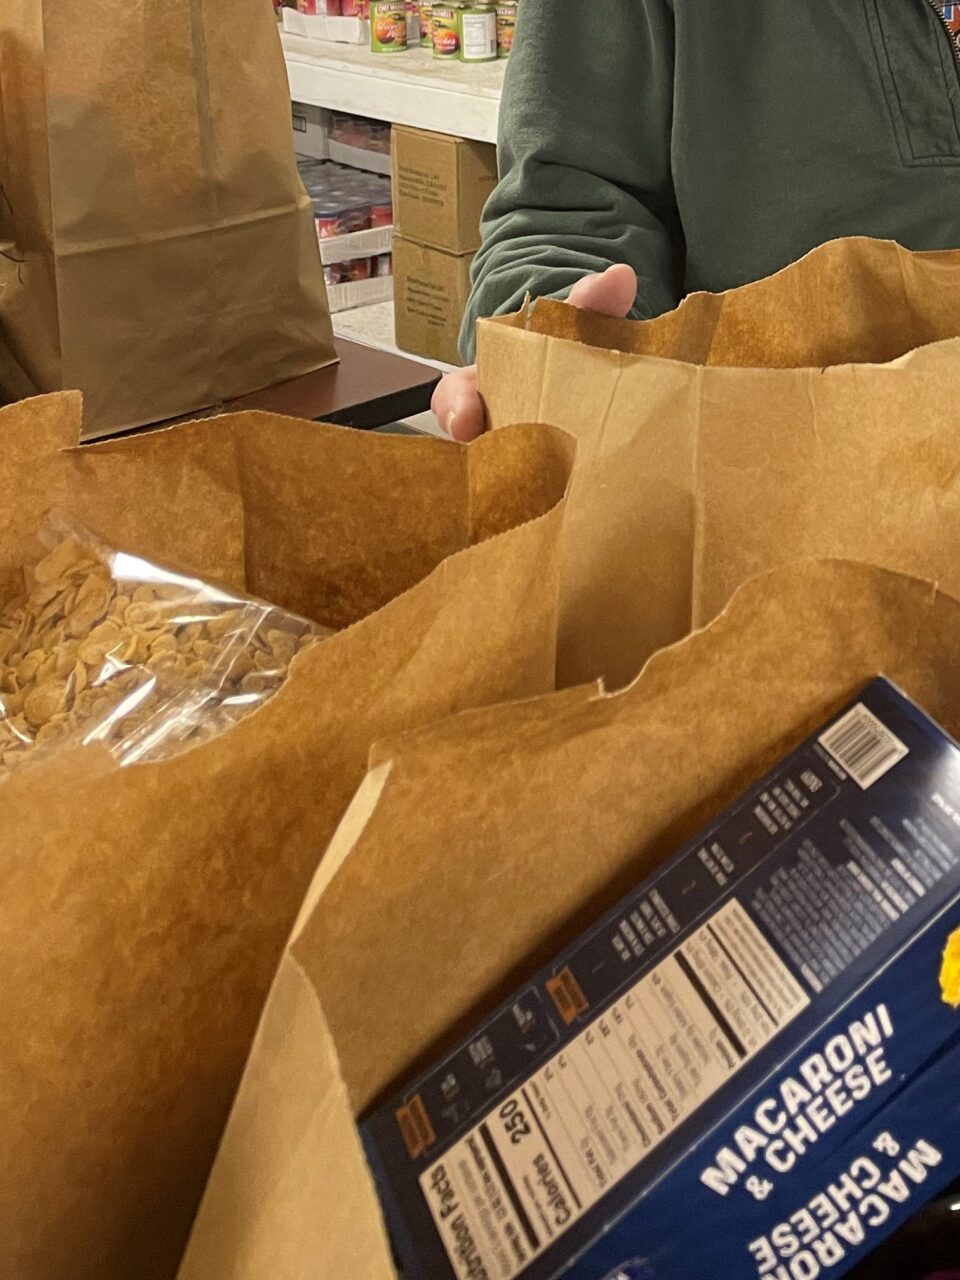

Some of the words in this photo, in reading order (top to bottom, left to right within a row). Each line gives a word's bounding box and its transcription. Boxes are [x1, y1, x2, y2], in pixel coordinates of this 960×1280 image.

[500, 1098, 531, 1144] 250
[700, 1004, 894, 1196] MACARONI
[745, 1175, 774, 1201] &
[765, 1047, 893, 1173] CHEESE
[872, 1131, 900, 1158] &
[430, 1163, 460, 1220] Facts
[532, 1153, 573, 1226] Calories
[749, 1156, 881, 1275] CHEESE
